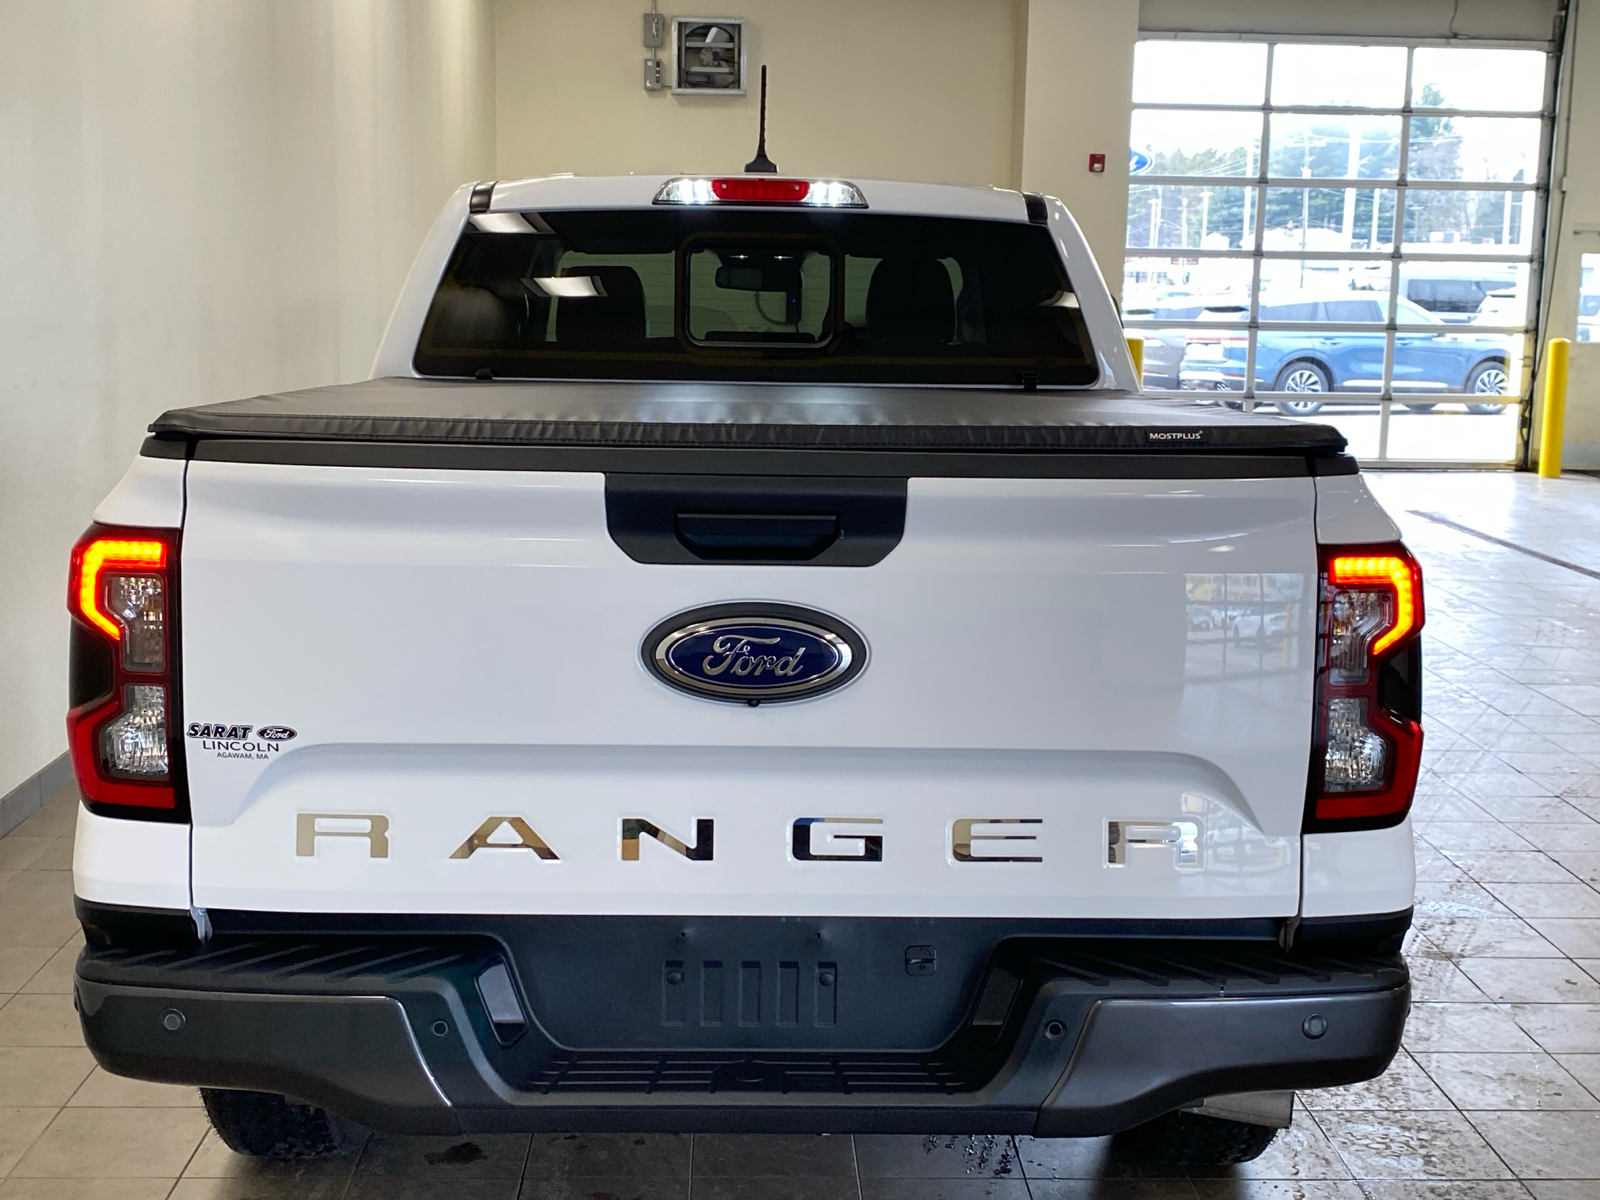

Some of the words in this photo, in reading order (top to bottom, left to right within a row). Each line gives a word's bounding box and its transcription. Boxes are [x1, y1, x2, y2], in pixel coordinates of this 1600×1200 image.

[703, 634, 806, 676] Ford
[186, 722, 253, 740] SARAT
[263, 728, 290, 739] Ford
[202, 740, 279, 752] LINCOLN
[217, 751, 254, 760] AGAWAM,
[296, 813, 1199, 867] RANGER
